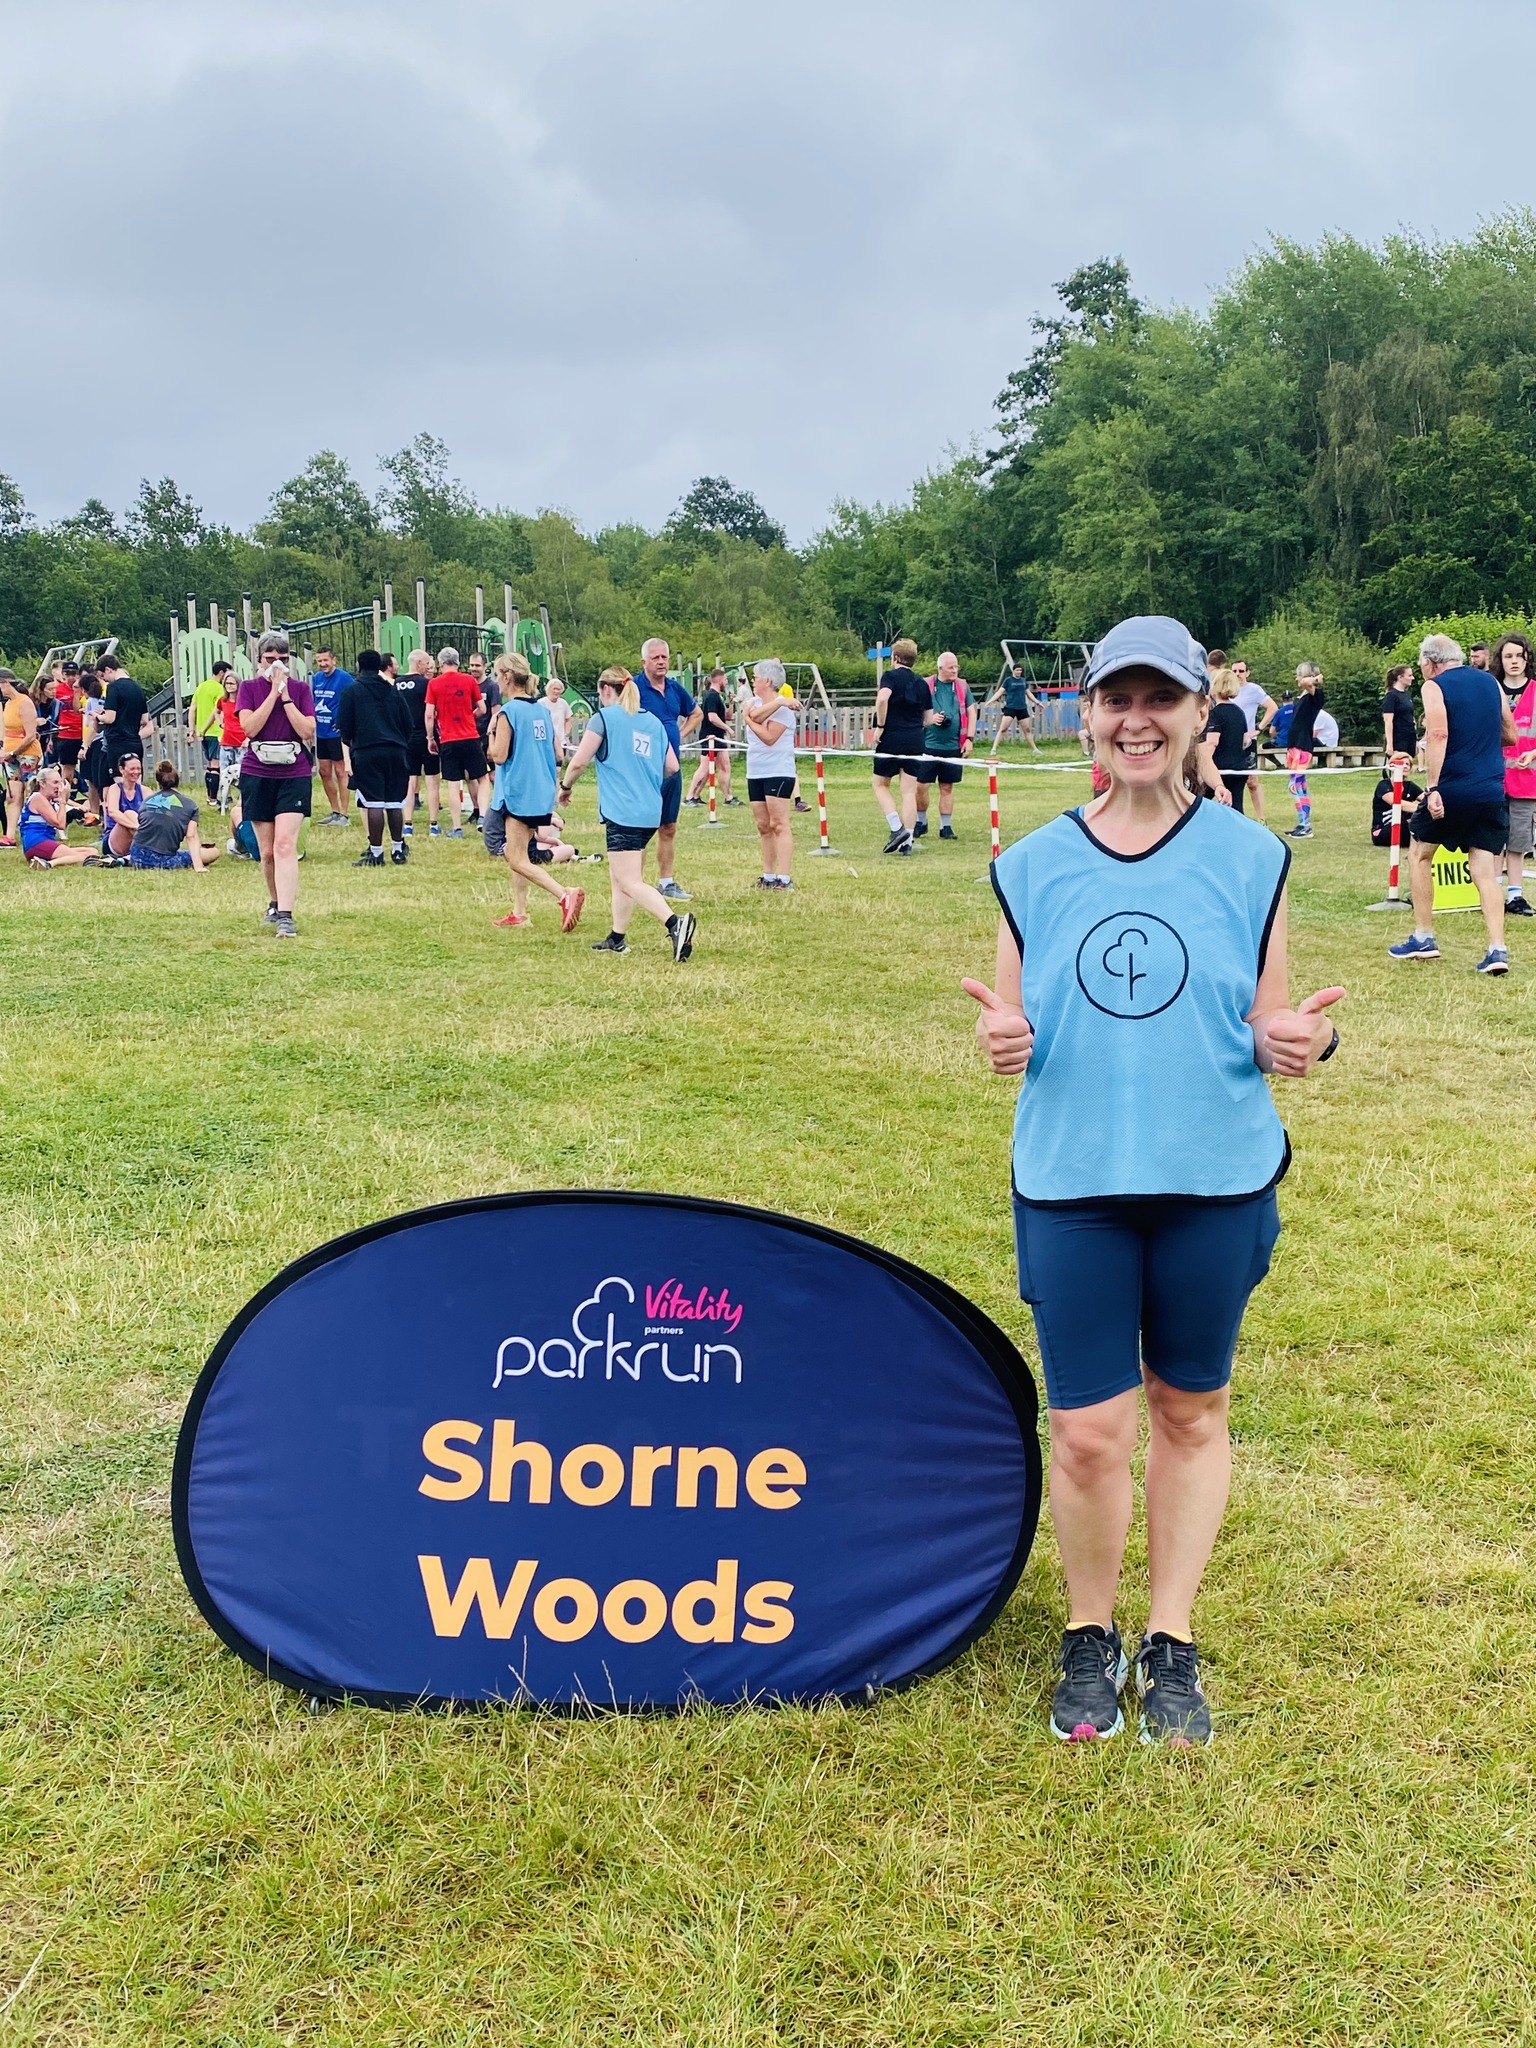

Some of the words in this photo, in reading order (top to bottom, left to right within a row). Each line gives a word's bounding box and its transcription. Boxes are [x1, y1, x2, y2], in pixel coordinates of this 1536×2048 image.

[396, 680, 416, 690] 100
[534, 725, 546, 740] 28
[634, 738, 650, 755] 27
[1431, 861, 1473, 886] INIS
[645, 1278, 743, 1334] Vitality
[644, 1325, 684, 1336] partners
[492, 1312, 743, 1389] parkrun
[417, 1418, 808, 1510] Shorne
[417, 1554, 795, 1644] Woods
